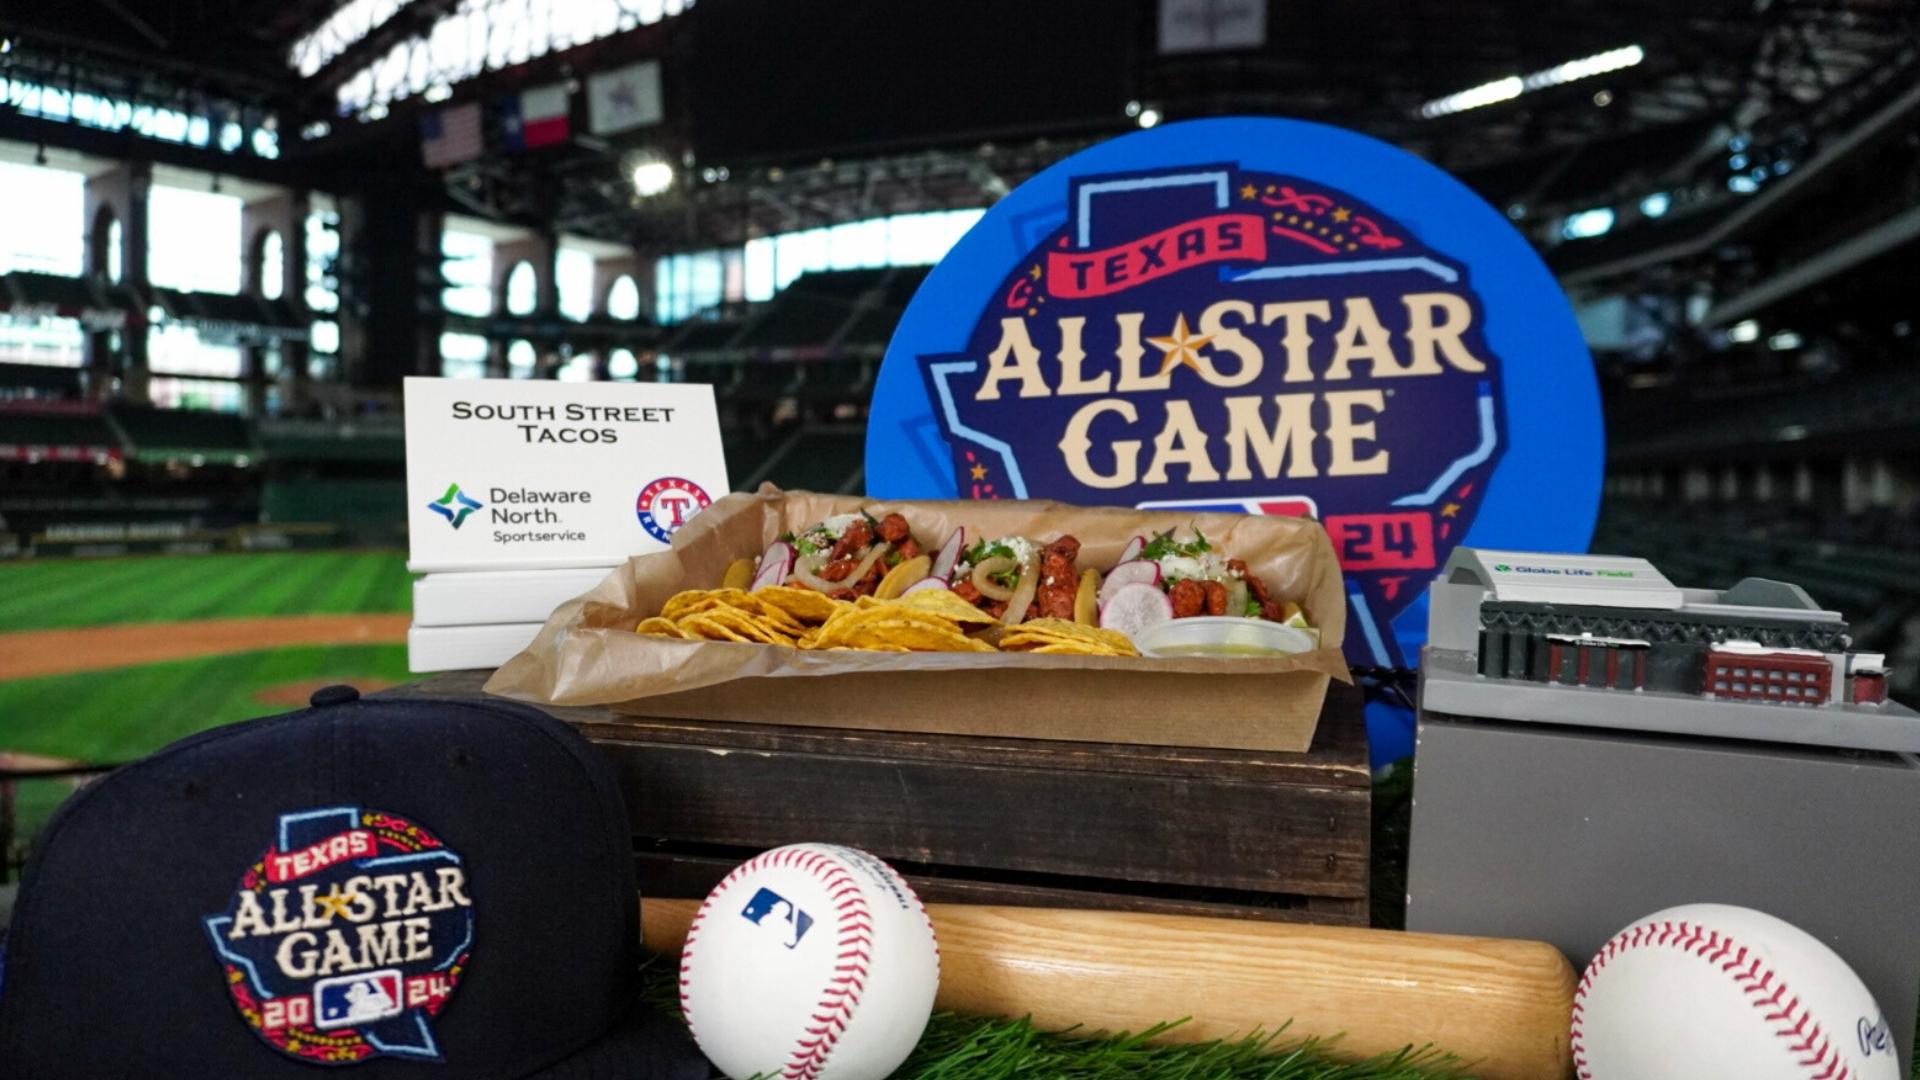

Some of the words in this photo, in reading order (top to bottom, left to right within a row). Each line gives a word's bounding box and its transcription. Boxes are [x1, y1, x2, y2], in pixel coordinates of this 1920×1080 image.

[1069, 221, 1244, 292] TEXAS
[451, 401, 555, 421] SOUTH
[565, 403, 676, 423] STREET
[517, 424, 619, 444] TACOS
[1057, 389, 1390, 490] GAME
[489, 487, 592, 504] Delaware
[644, 479, 702, 498] TEXAS
[491, 507, 558, 525] North
[493, 530, 587, 545] Sportservice
[1343, 521, 1418, 561] 24
[1515, 565, 1562, 576] Globe
[1564, 568, 1594, 577] Life
[1596, 569, 1635, 578] Field
[274, 831, 369, 881] TEXAS
[274, 917, 433, 979] GAME
[262, 997, 309, 1028] 20
[408, 976, 452, 1005] 24
